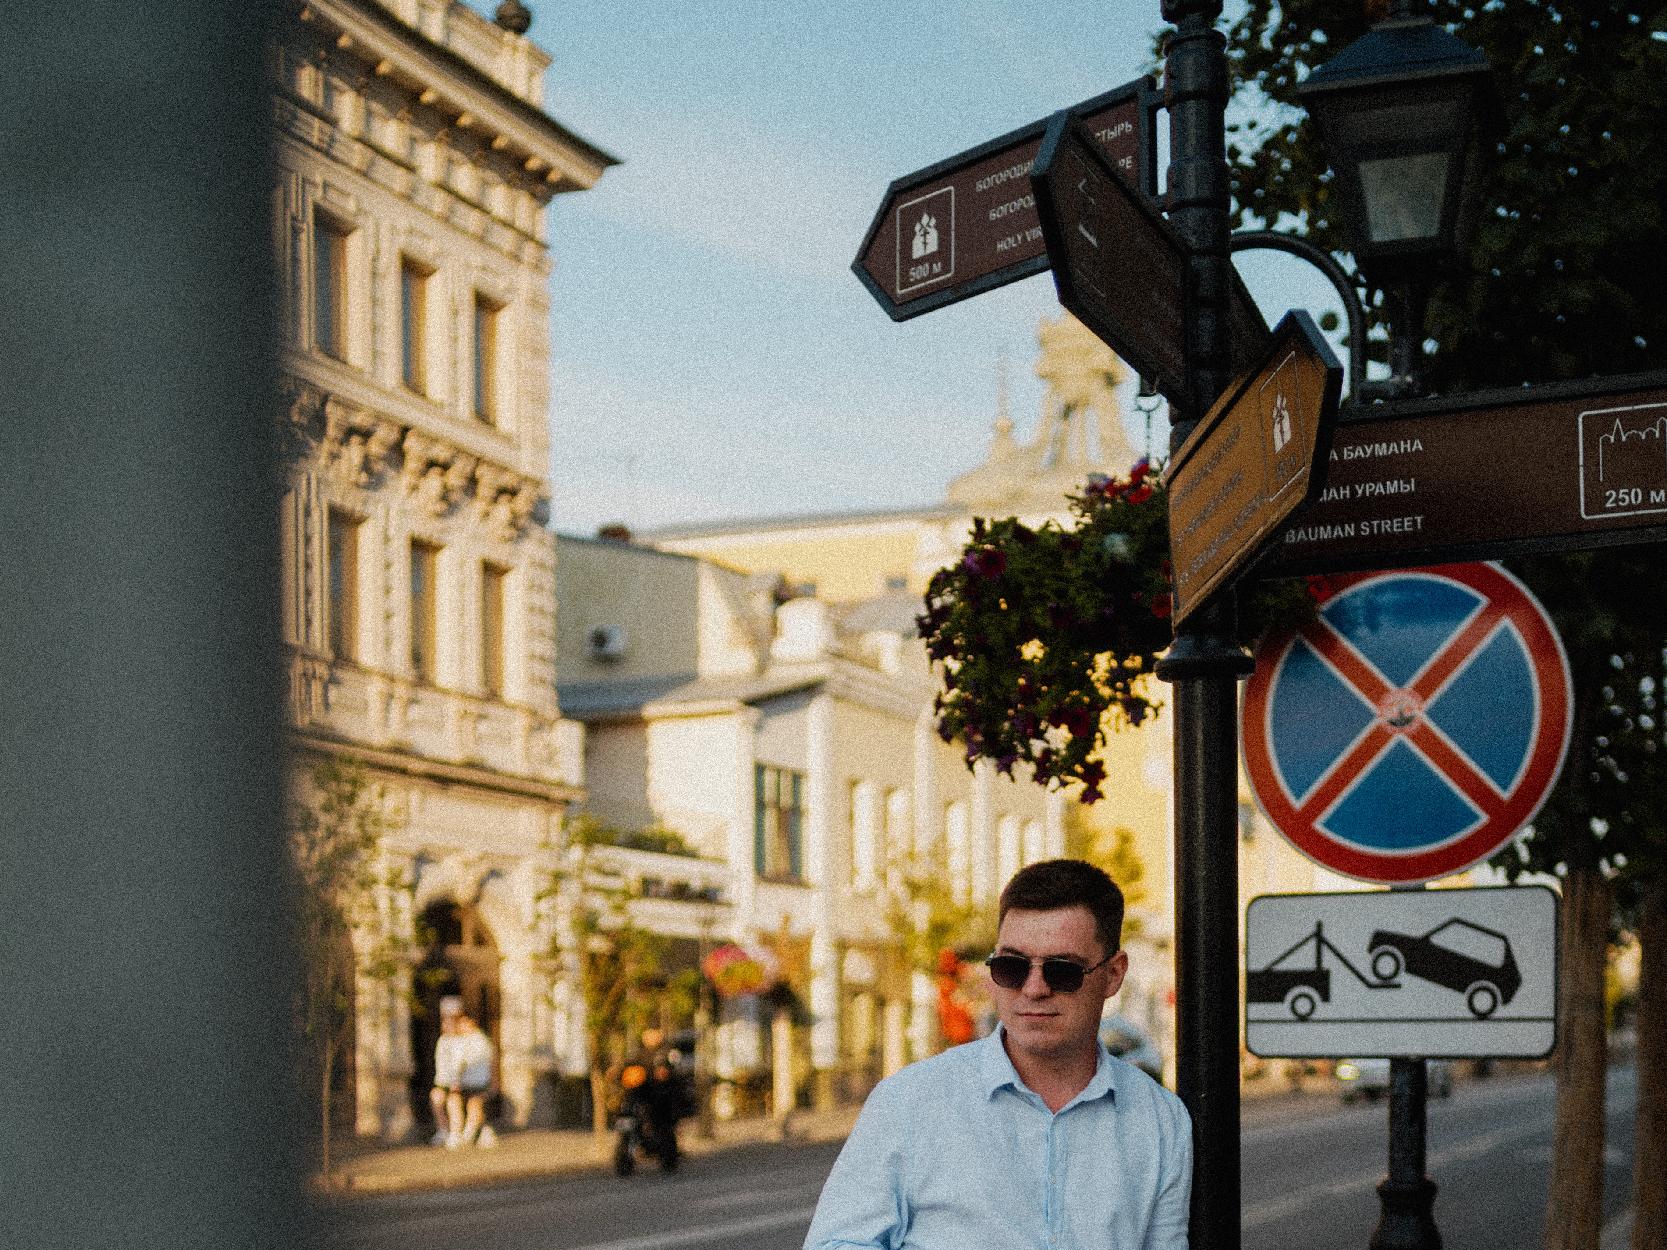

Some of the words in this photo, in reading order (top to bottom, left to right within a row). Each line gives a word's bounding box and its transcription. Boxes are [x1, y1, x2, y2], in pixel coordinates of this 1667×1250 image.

[997, 232, 1023, 252] HOLY
[1343, 438, 1423, 461] БАУМАНА
[1355, 477, 1416, 498] УРАМЫ
[1605, 487, 1643, 508] 250
[1285, 523, 1356, 543] BAUMAN
[1360, 516, 1424, 536] STREET
